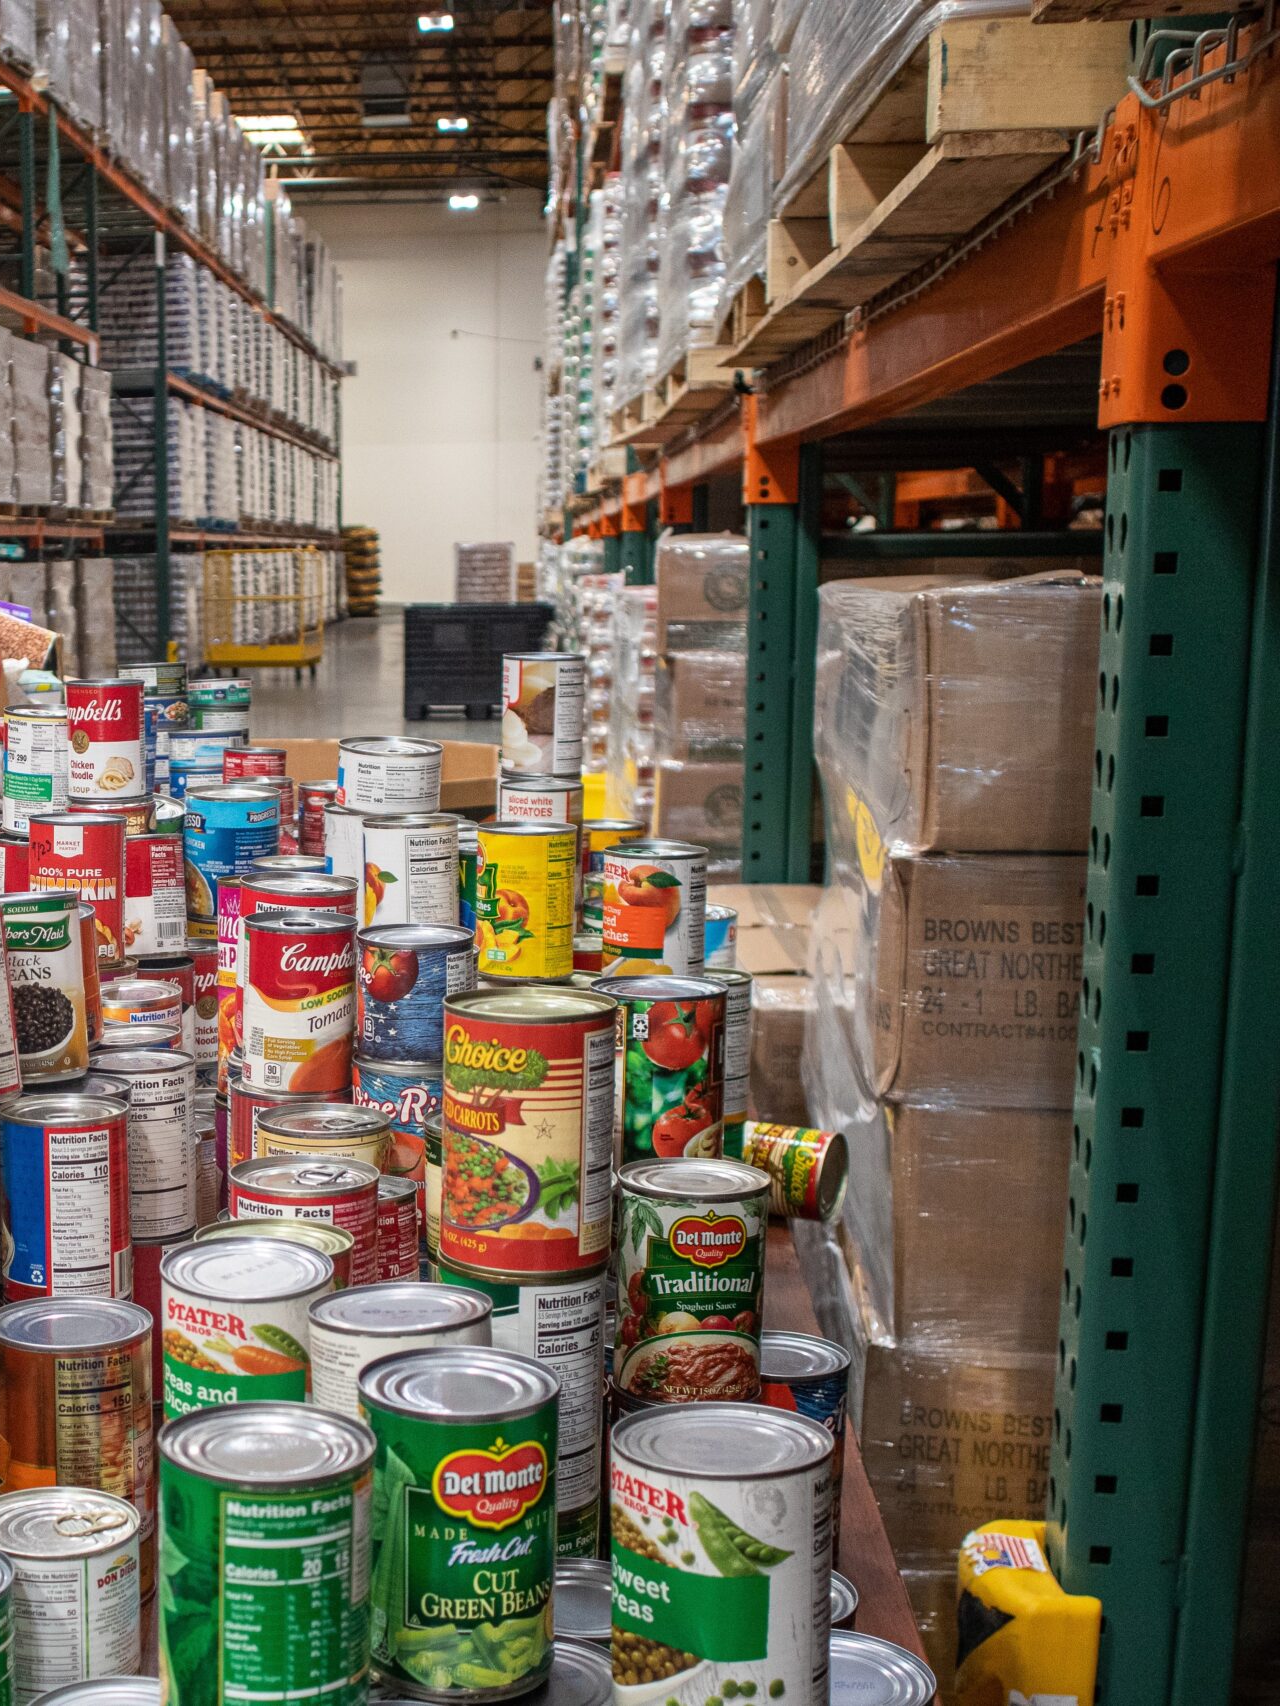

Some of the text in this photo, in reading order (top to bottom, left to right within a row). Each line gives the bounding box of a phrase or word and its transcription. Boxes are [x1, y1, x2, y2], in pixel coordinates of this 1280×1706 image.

[17, 754, 27, 763] 290
[70, 759, 95, 770] Chicken
[71, 771, 94, 781] Noodle
[508, 796, 553, 805] sliced white
[250, 808, 277, 822] PROGRESSO
[508, 806, 553, 817] POTATOES
[410, 837, 452, 846] Nutrition Facts
[38, 867, 102, 877] 100% PURE
[7, 905, 38, 914] SODIUM
[28, 925, 64, 945] Maid
[923, 918, 1085, 945] BROWNS BEST
[923, 950, 1083, 982] GREAT NORTHE
[301, 998, 324, 1011] LOW
[1013, 989, 1043, 1018] LB.
[131, 1013, 166, 1023] Nutrition
[307, 1003, 352, 1033] Tomato
[446, 1023, 528, 1074] Choice
[267, 1065, 277, 1074] 90
[162, 1075, 185, 1087] Facts
[173, 1106, 186, 1116] 110
[455, 1104, 500, 1132] CARROTS
[51, 1133, 108, 1145] Nutrition Facts
[51, 1165, 109, 1179] Calories 110
[790, 1146, 817, 1201] Choice
[238, 1198, 331, 1219] Nutrition Facts
[676, 1230, 743, 1246] Del Monte
[695, 1248, 723, 1259] Quality
[389, 1264, 400, 1276] 70
[650, 1271, 755, 1295] Traditional
[538, 1287, 601, 1310] Nutrition Facts
[676, 1300, 737, 1312] Spaghetti Sauce
[167, 1298, 247, 1341] STATER
[537, 1321, 560, 1329] Serving
[573, 1318, 581, 1326] 1/2
[581, 1316, 591, 1324] cup
[186, 1323, 212, 1336] BROS
[537, 1329, 600, 1354] Calories 45
[58, 1354, 132, 1372] Nutrition Facts
[164, 1362, 238, 1404] Peas and
[663, 1385, 698, 1395] NET WT
[58, 1393, 132, 1413] Calories 150
[899, 1404, 1053, 1438] BROWNS BEST
[898, 1433, 962, 1464] GREAT
[443, 1462, 544, 1497] Del Monte
[984, 1475, 1012, 1502] LB.
[225, 1495, 352, 1521] Nutrition Facts
[475, 1497, 520, 1515] Quality
[623, 1497, 650, 1516] BROS
[414, 1523, 468, 1541] MADE
[447, 1535, 537, 1567] Fresh Cut
[97, 1560, 138, 1589] DON DIEGO
[225, 1561, 278, 1582] Calories
[302, 1552, 351, 1579] 20 15
[472, 1567, 519, 1595] CUT
[610, 1553, 671, 1603] Sweet
[420, 1580, 553, 1620] GREEN BEANS
[610, 1579, 655, 1624] Peas
[67, 1609, 77, 1617] 50
